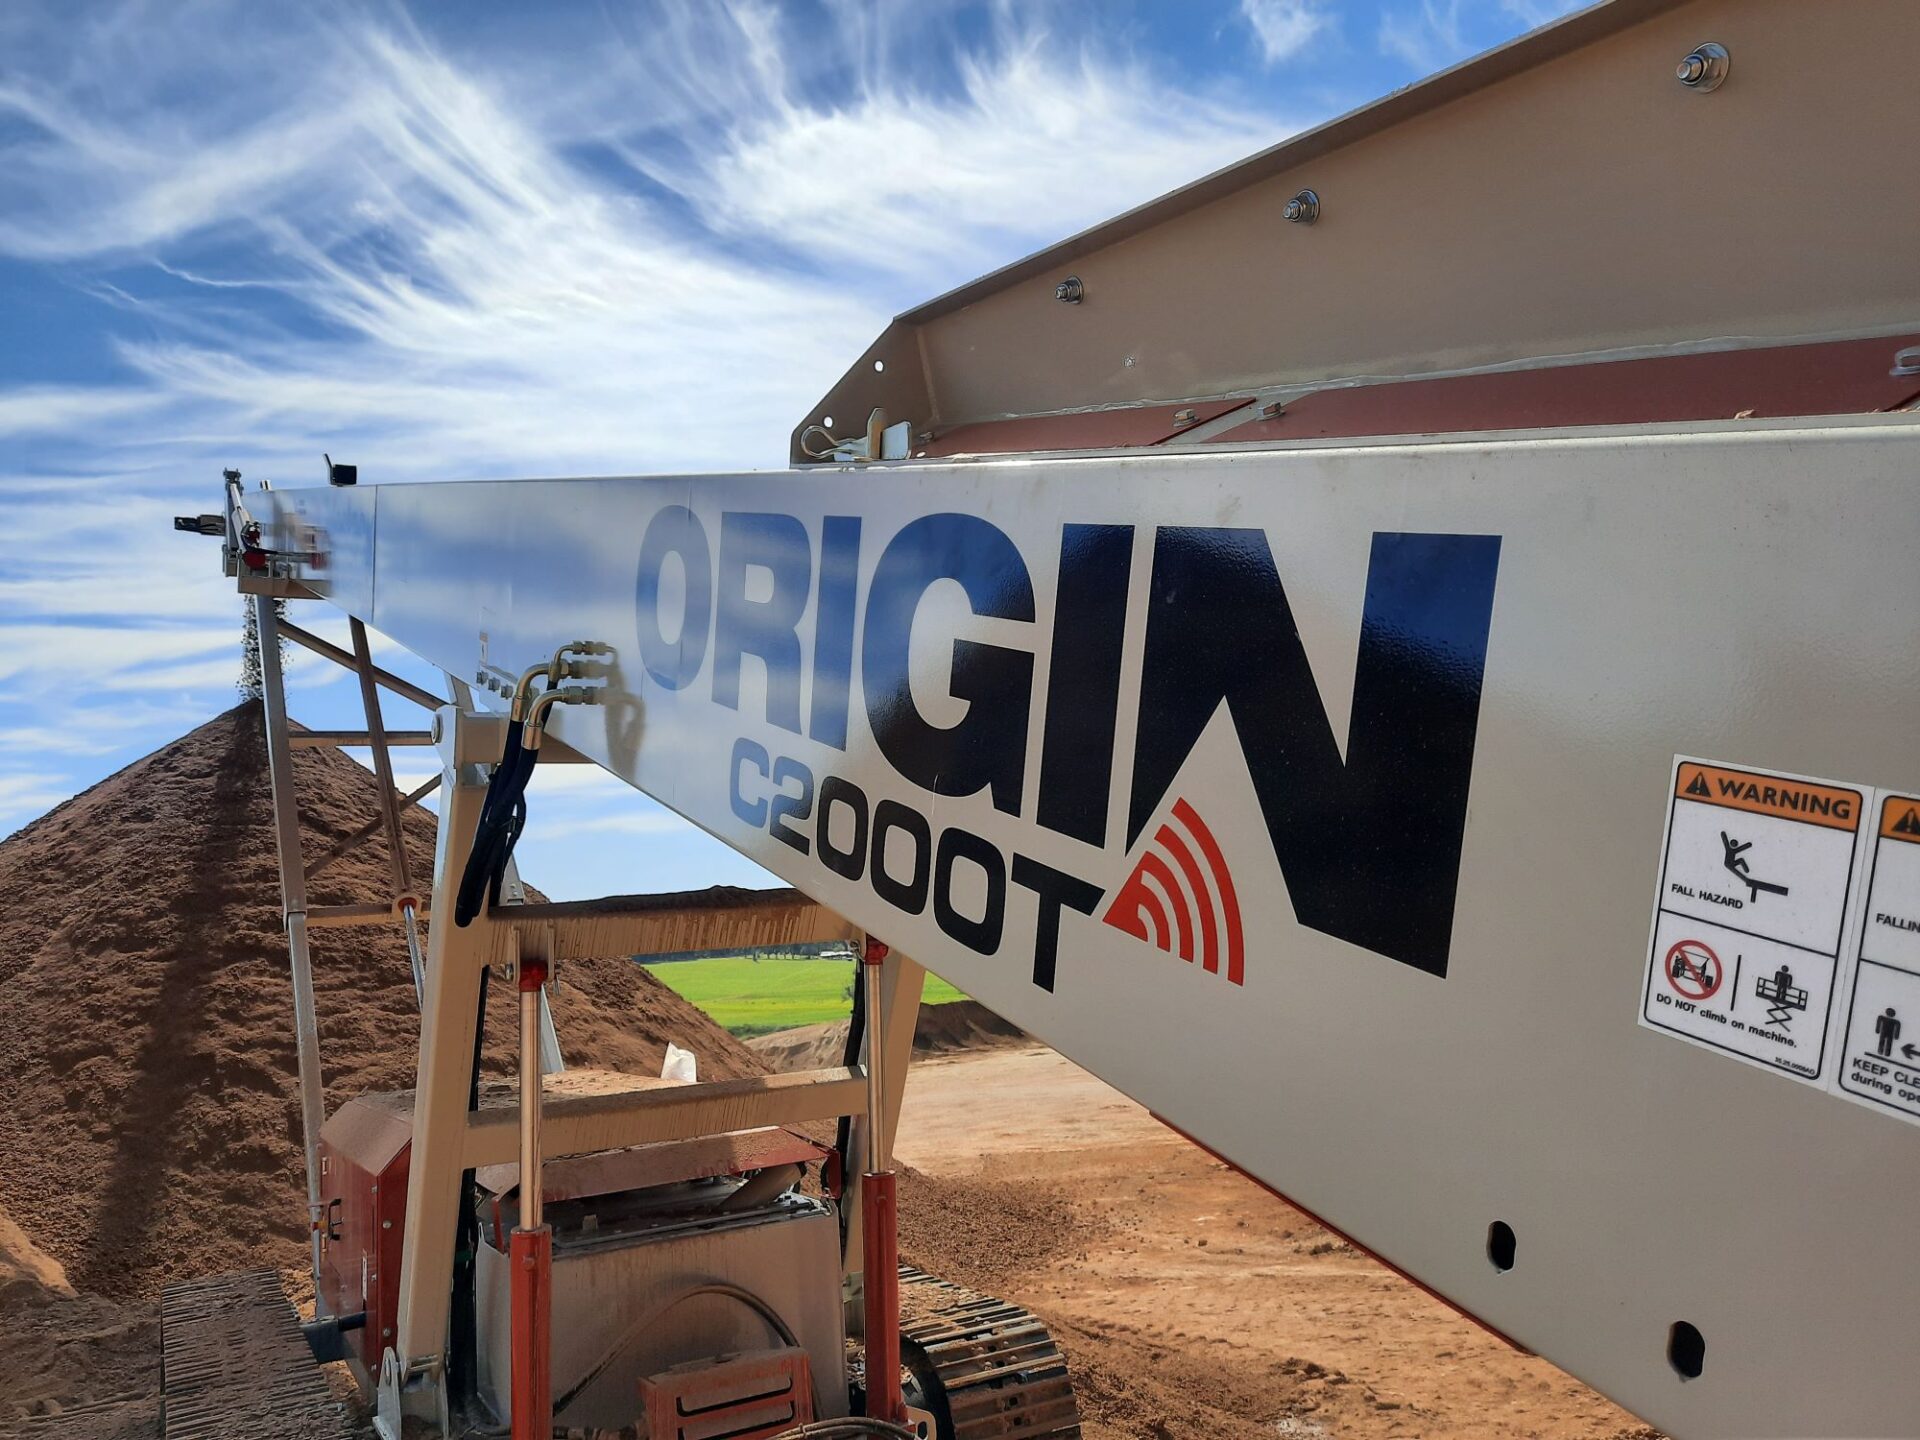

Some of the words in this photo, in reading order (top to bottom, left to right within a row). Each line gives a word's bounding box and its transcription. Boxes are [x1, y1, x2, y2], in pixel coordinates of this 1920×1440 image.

[636, 505, 1502, 978] ORIGIN
[1718, 778, 1851, 820] WARNING
[729, 737, 1106, 994] C2000T
[1671, 883, 1695, 898] FALL
[1699, 890, 1744, 910] HAZARD
[1656, 993, 1672, 1006] DO
[1675, 999, 1697, 1014] NOT
[1700, 1008, 1727, 1024] climb
[1731, 1018, 1745, 1031] on
[1748, 1025, 1798, 1048] machine.
[1851, 1071, 1893, 1095] during
[1853, 1057, 1890, 1077] KEEP
